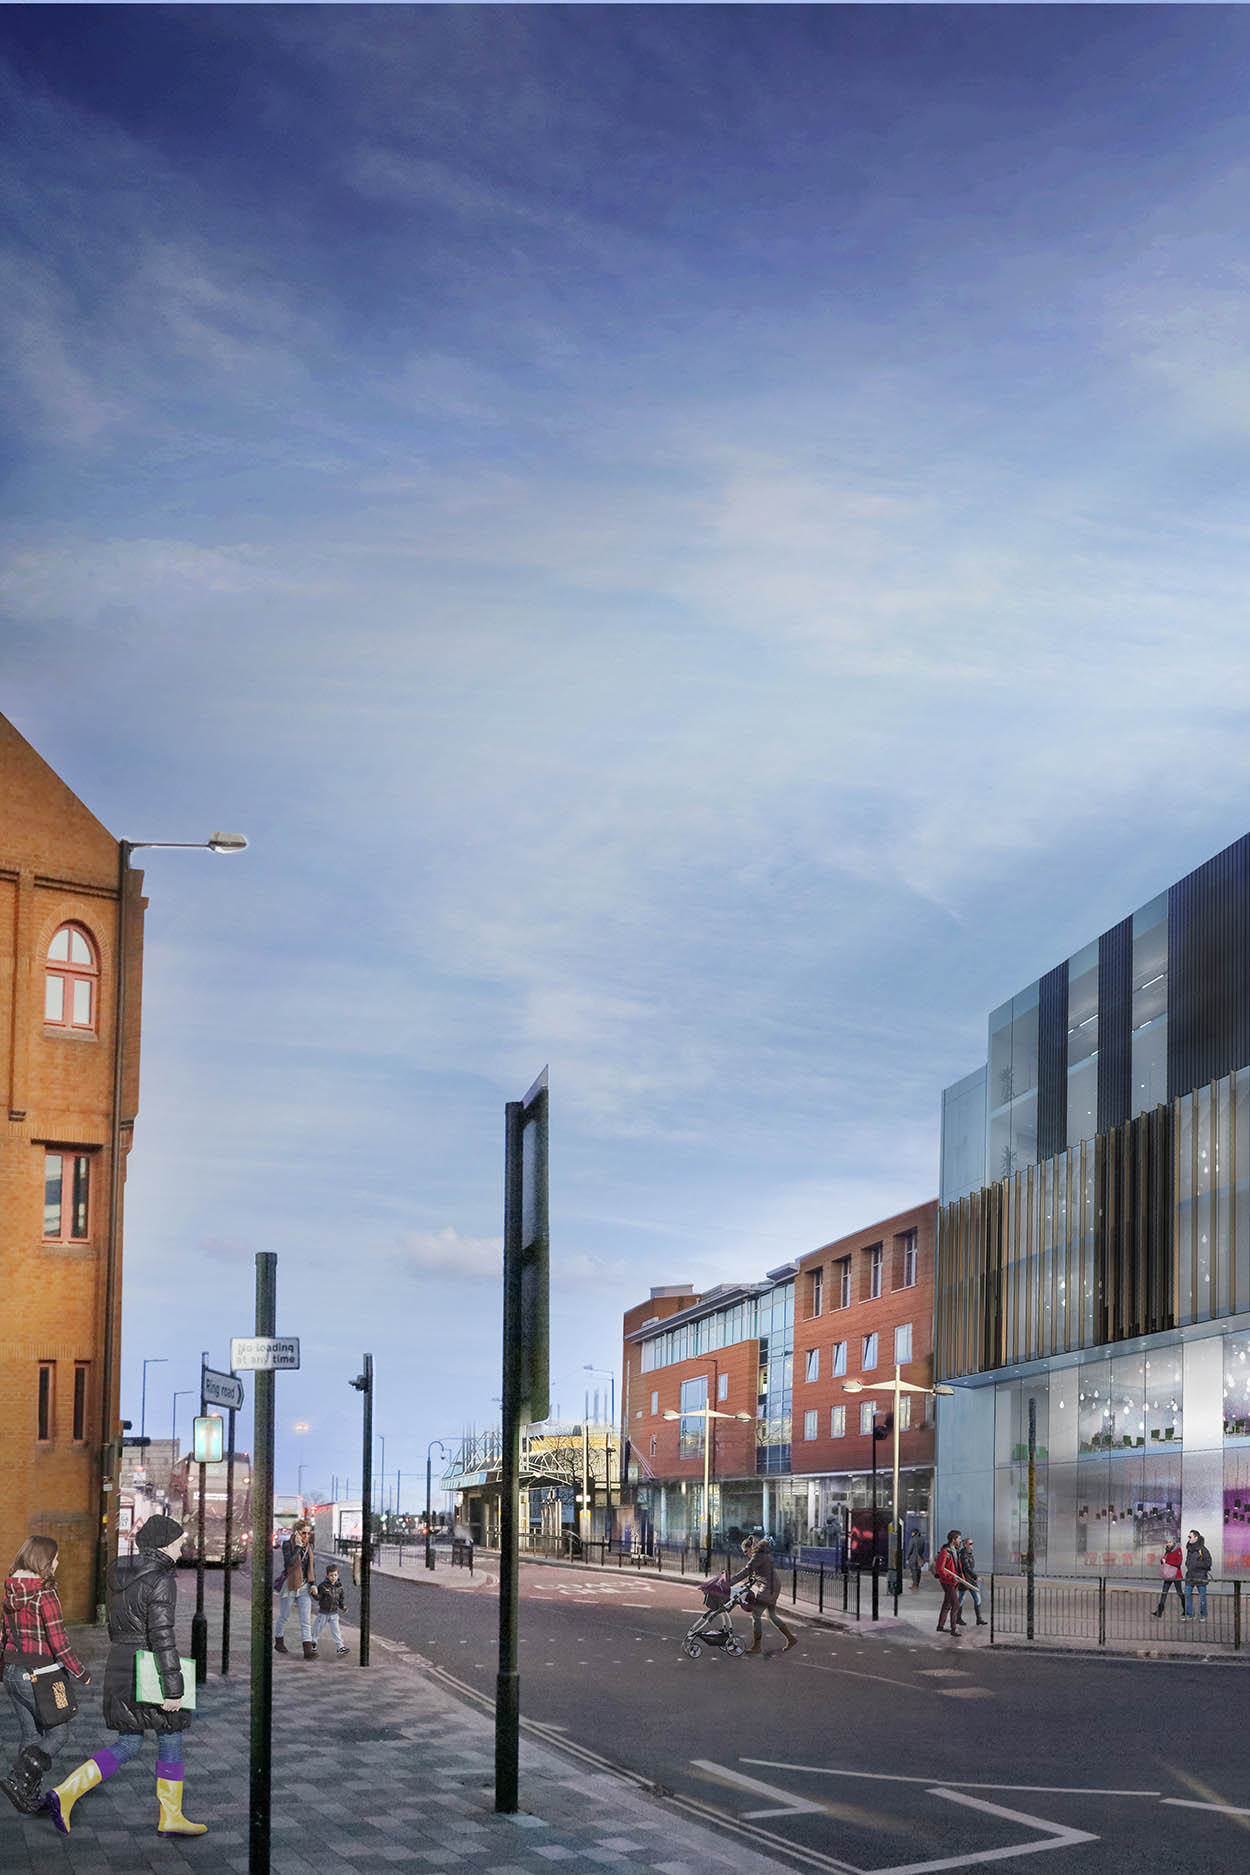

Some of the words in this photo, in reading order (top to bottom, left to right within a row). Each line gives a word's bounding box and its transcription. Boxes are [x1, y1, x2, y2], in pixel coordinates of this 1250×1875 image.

[256, 1343, 294, 1353] loading
[251, 1356, 269, 1365] any
[273, 1355, 295, 1364] time
[206, 1379, 220, 1398] Ring
[221, 1386, 235, 1399] road
